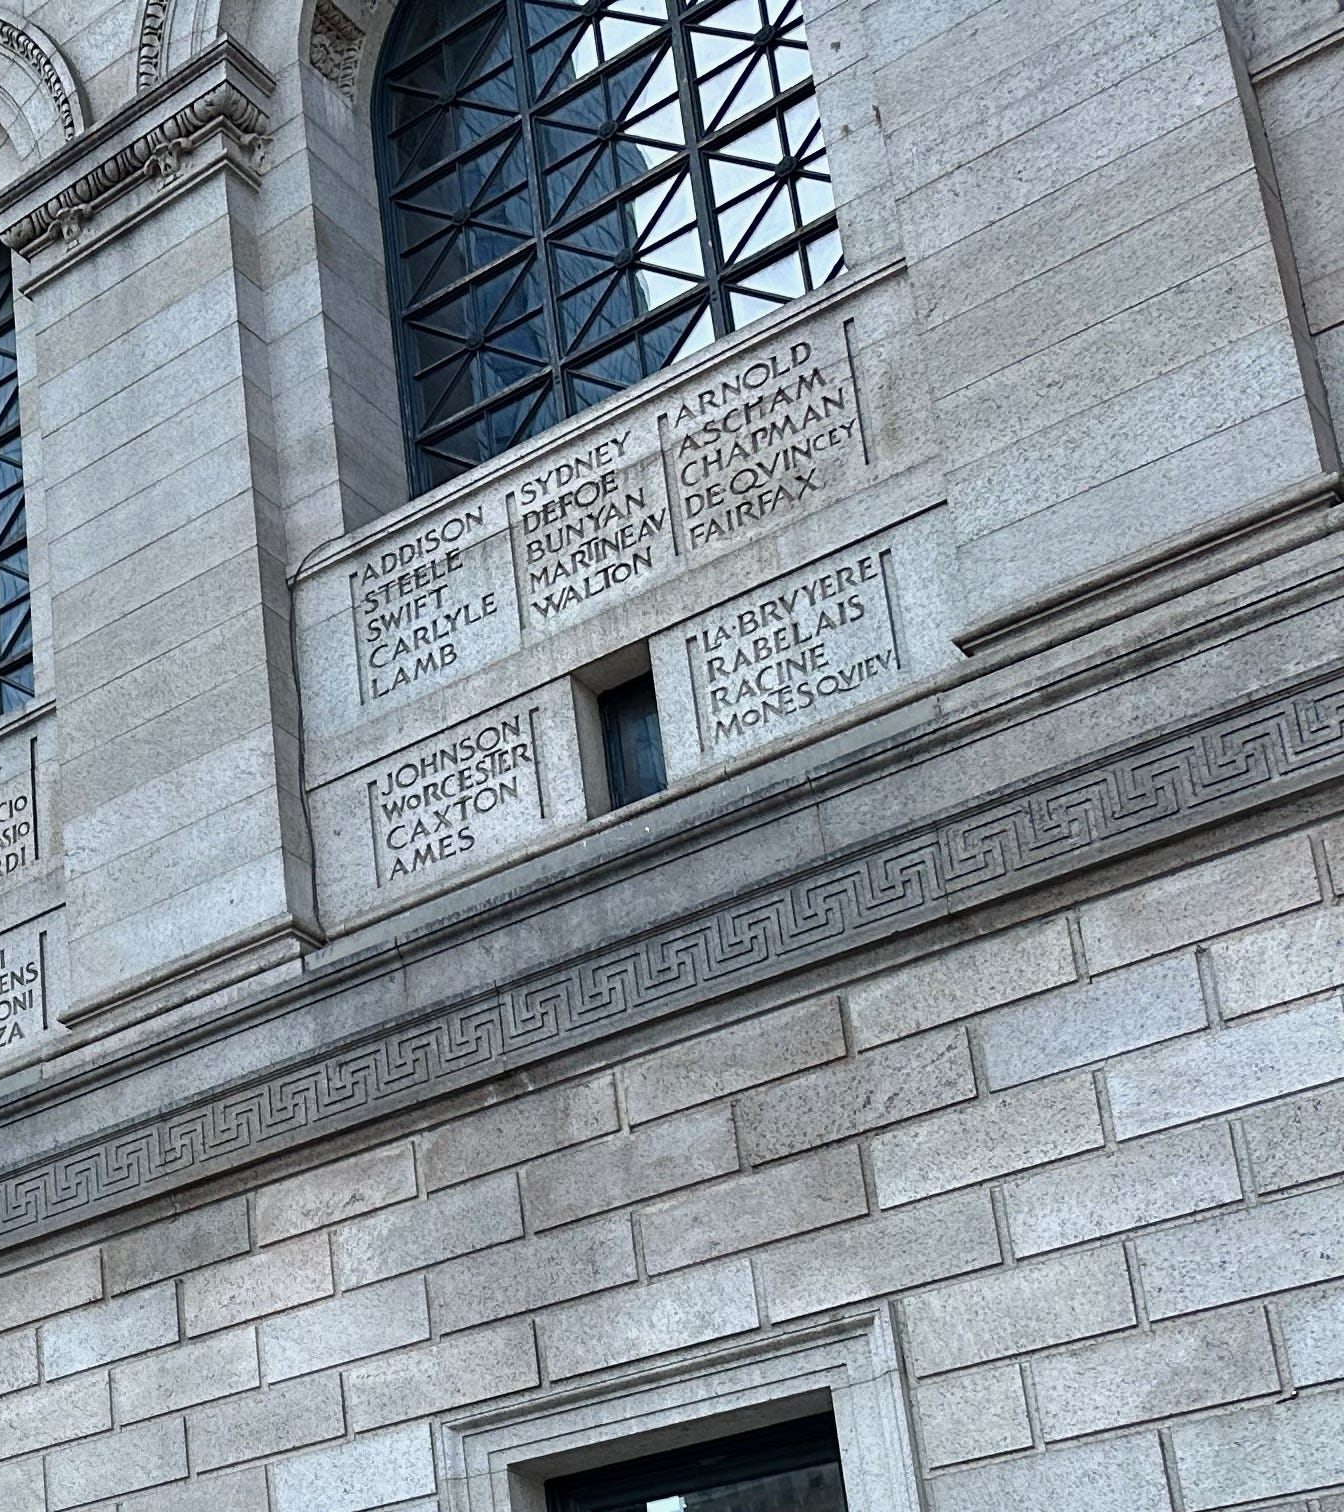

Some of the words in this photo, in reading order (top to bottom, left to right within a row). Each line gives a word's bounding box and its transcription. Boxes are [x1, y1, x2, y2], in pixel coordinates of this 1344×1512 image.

[674, 341, 812, 428] ARNOLD
[679, 367, 827, 458] ASCHAM
[520, 431, 632, 506] SYDNEY
[681, 387, 846, 487] CHAPMAN
[523, 470, 619, 535] DEFOE
[526, 488, 648, 565] BUNYAN
[684, 483, 725, 520] DE
[689, 467, 820, 550] FAIRFAX
[361, 506, 484, 586] ADDISON
[364, 547, 463, 615] STEELE
[532, 546, 653, 622] WALTON
[366, 584, 448, 642] SWIFT
[369, 592, 498, 669] CARLYLE
[707, 594, 864, 683] RABELAIS
[371, 643, 458, 699] LAMB
[711, 642, 830, 713] RACINE
[381, 715, 521, 796] JOHNSON
[381, 743, 532, 824] WORCESTER
[386, 776, 519, 850] CAXTON
[389, 826, 476, 881] AMES
